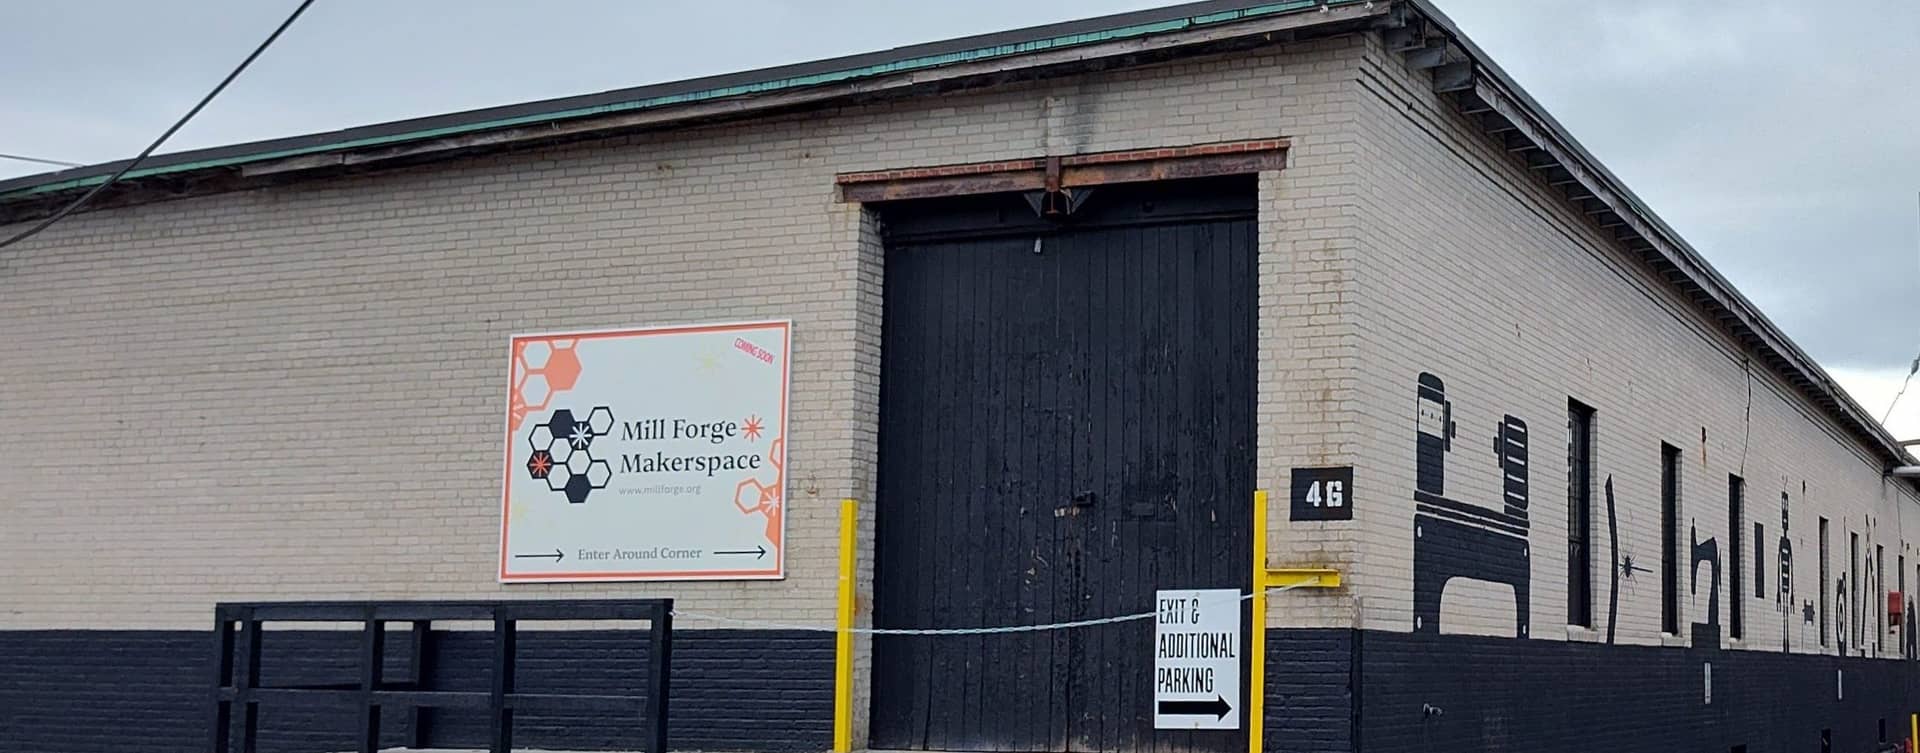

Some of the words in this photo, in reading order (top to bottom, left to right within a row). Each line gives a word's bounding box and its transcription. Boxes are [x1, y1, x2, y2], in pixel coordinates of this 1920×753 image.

[734, 337, 758, 357] COMING
[757, 348, 775, 365] SOON
[621, 418, 666, 441] Mill
[672, 418, 737, 444] Forge
[620, 451, 761, 477] Makerspace
[619, 484, 702, 496] www.millforge.org
[578, 549, 610, 561] Enter
[613, 547, 658, 561] Around
[660, 547, 702, 560] Corner
[1159, 598, 1186, 625] EXIT
[1191, 598, 1200, 625] &
[1158, 632, 1236, 659] ADDITIONAL
[1157, 667, 1214, 693] PARKING
